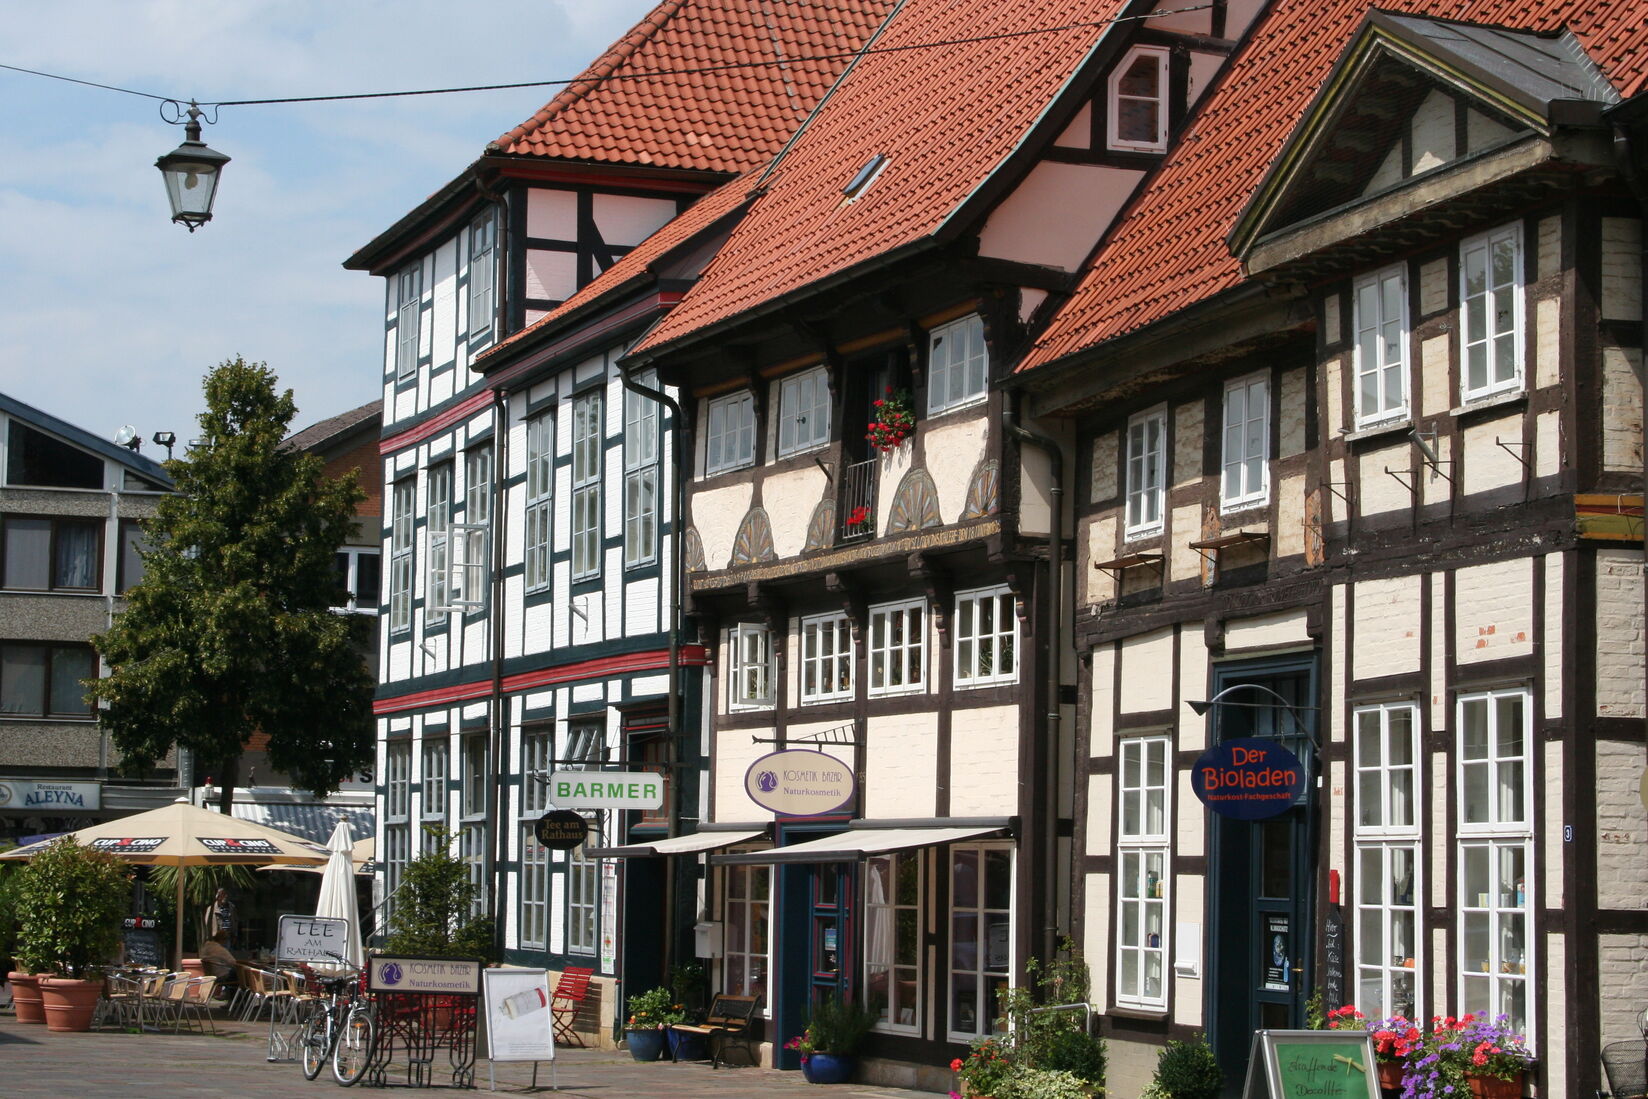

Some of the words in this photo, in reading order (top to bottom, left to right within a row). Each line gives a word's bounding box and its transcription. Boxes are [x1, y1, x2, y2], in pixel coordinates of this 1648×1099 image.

[1232, 747, 1267, 766] Der
[783, 770, 818, 782] KOSMETIK
[822, 771, 843, 782] BAZAR
[1202, 767, 1296, 790] Bioladen
[557, 782, 657, 799] BARMER
[783, 787, 842, 797] Naturkosmetik
[25, 790, 85, 807] ALEYNA
[543, 819, 561, 829] Tee
[563, 821, 580, 829] am
[541, 830, 584, 840] Rathaus
[293, 921, 335, 938] TEE
[304, 939, 322, 947] AM
[409, 962, 446, 975] KOSMETIK
[450, 964, 471, 976] BAZAR
[409, 979, 471, 989] Naturkosmetik
